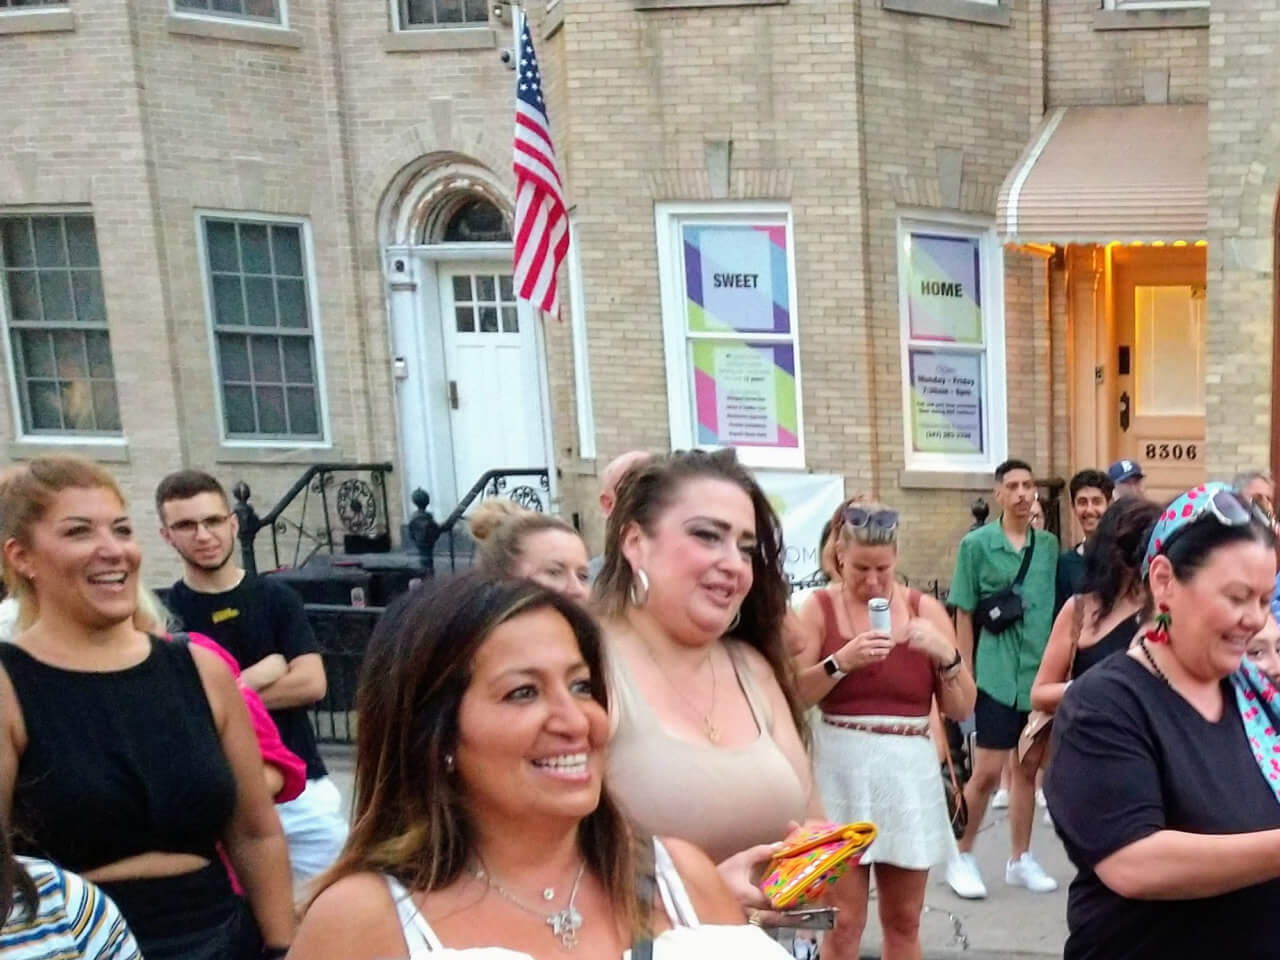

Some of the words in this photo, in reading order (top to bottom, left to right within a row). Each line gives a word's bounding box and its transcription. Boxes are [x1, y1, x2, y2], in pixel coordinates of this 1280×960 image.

[713, 272, 759, 288] SWEET
[921, 280, 963, 298] HOME
[1145, 443, 1197, 460] 8306
